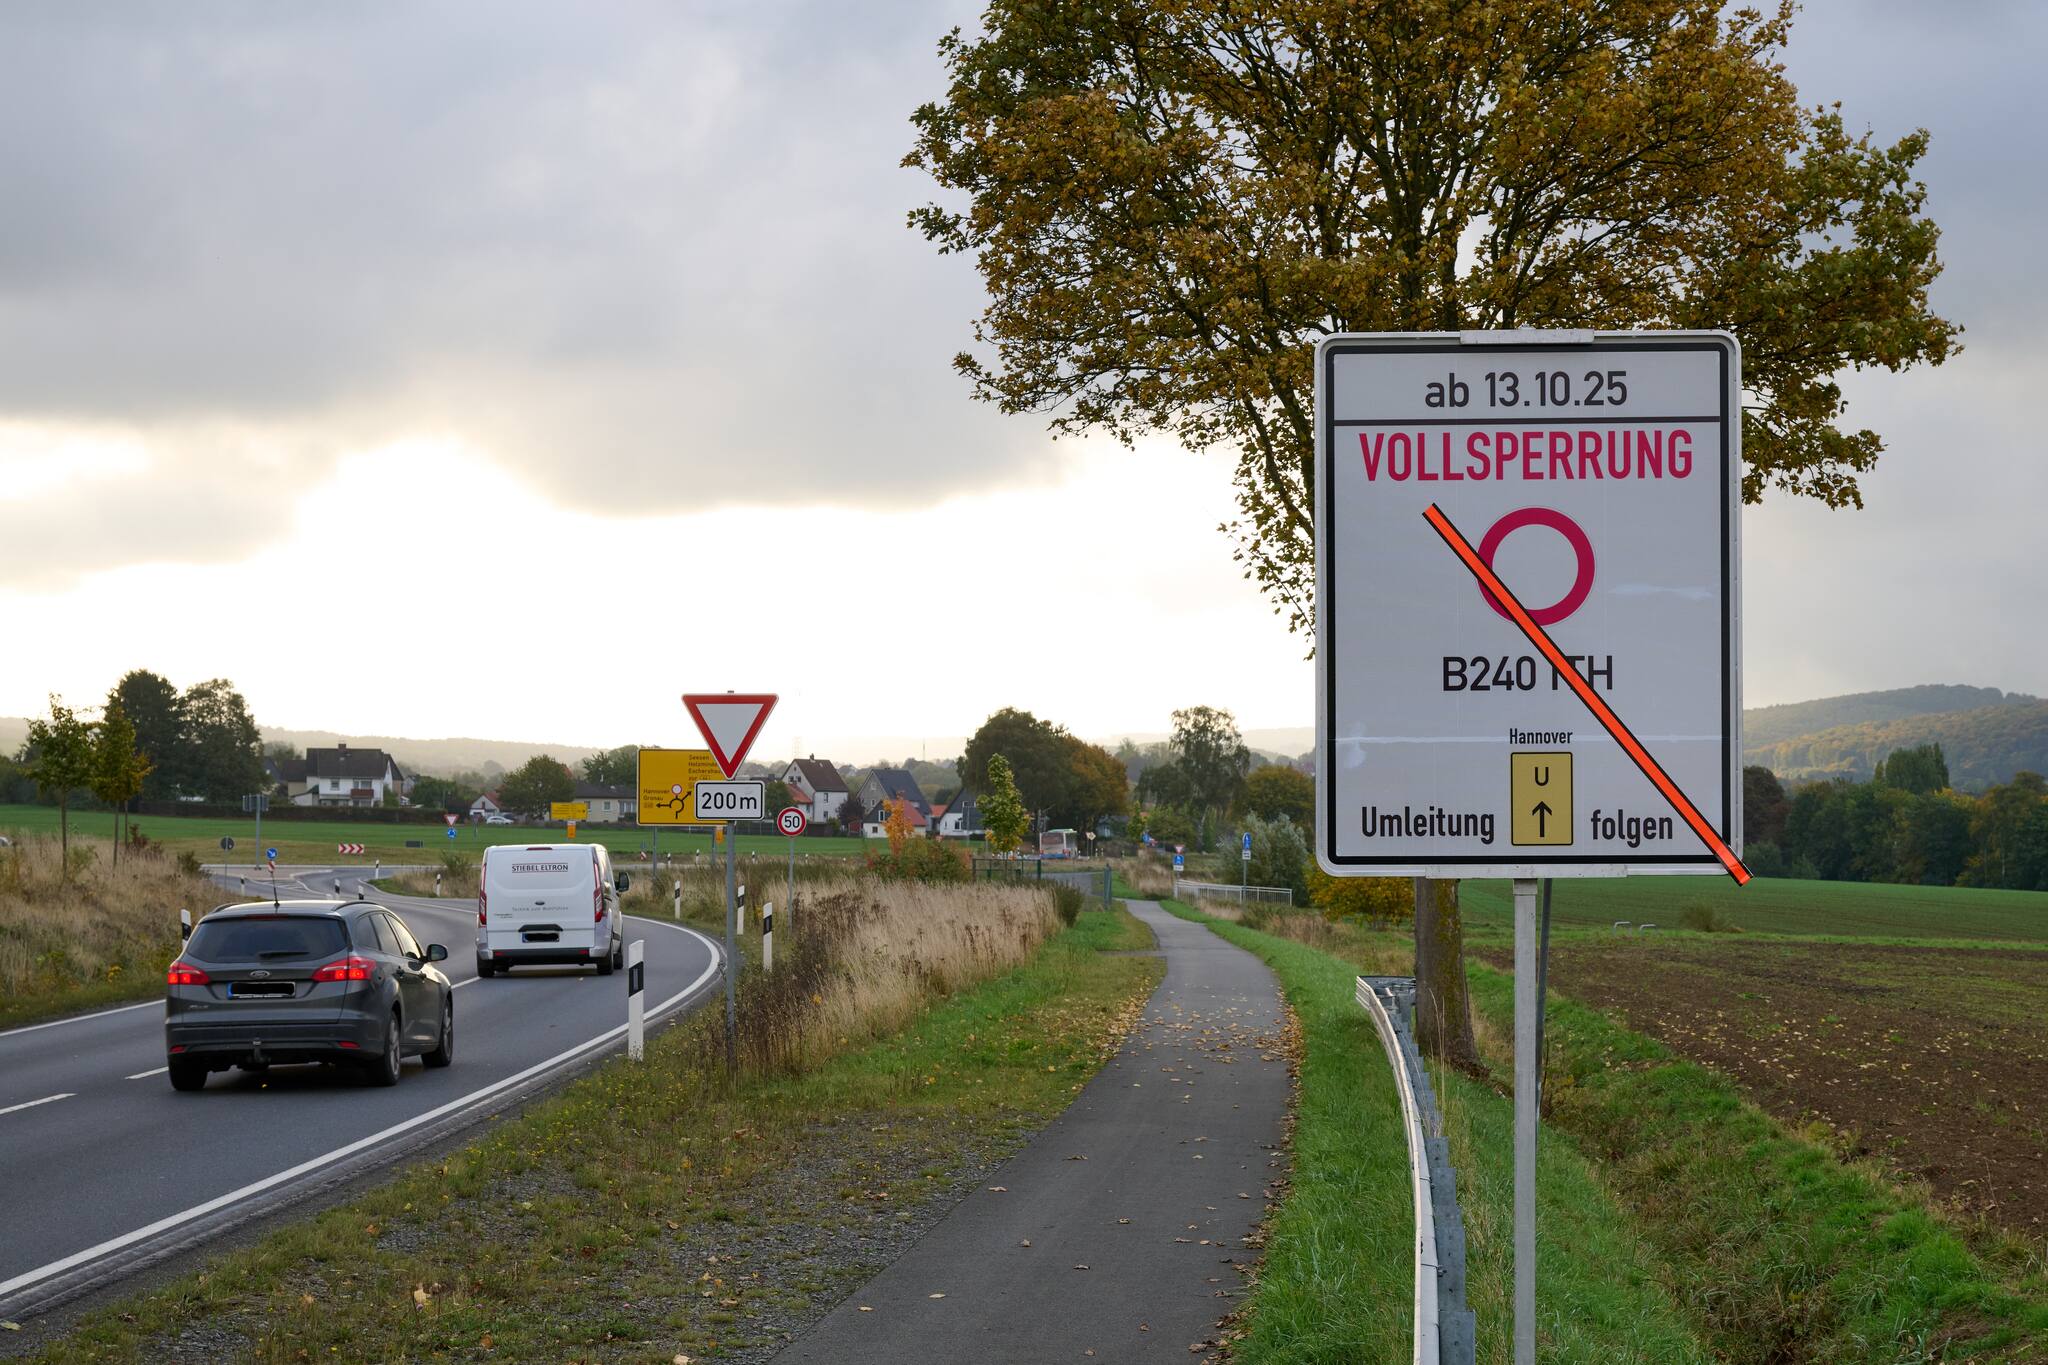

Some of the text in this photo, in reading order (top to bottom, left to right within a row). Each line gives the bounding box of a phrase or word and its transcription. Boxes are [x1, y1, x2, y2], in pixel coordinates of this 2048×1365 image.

[1425, 371, 1628, 408] ab 13.10.25
[1359, 429, 1693, 481] VOLLSPERRUNG
[1443, 656, 1536, 692] B240
[1509, 728, 1574, 745] Hannover
[1534, 766, 1549, 786] U
[784, 815, 800, 828] 50
[1361, 806, 1673, 848] Umleitung folgen
[512, 864, 568, 873] STIEBEL ELTRON
